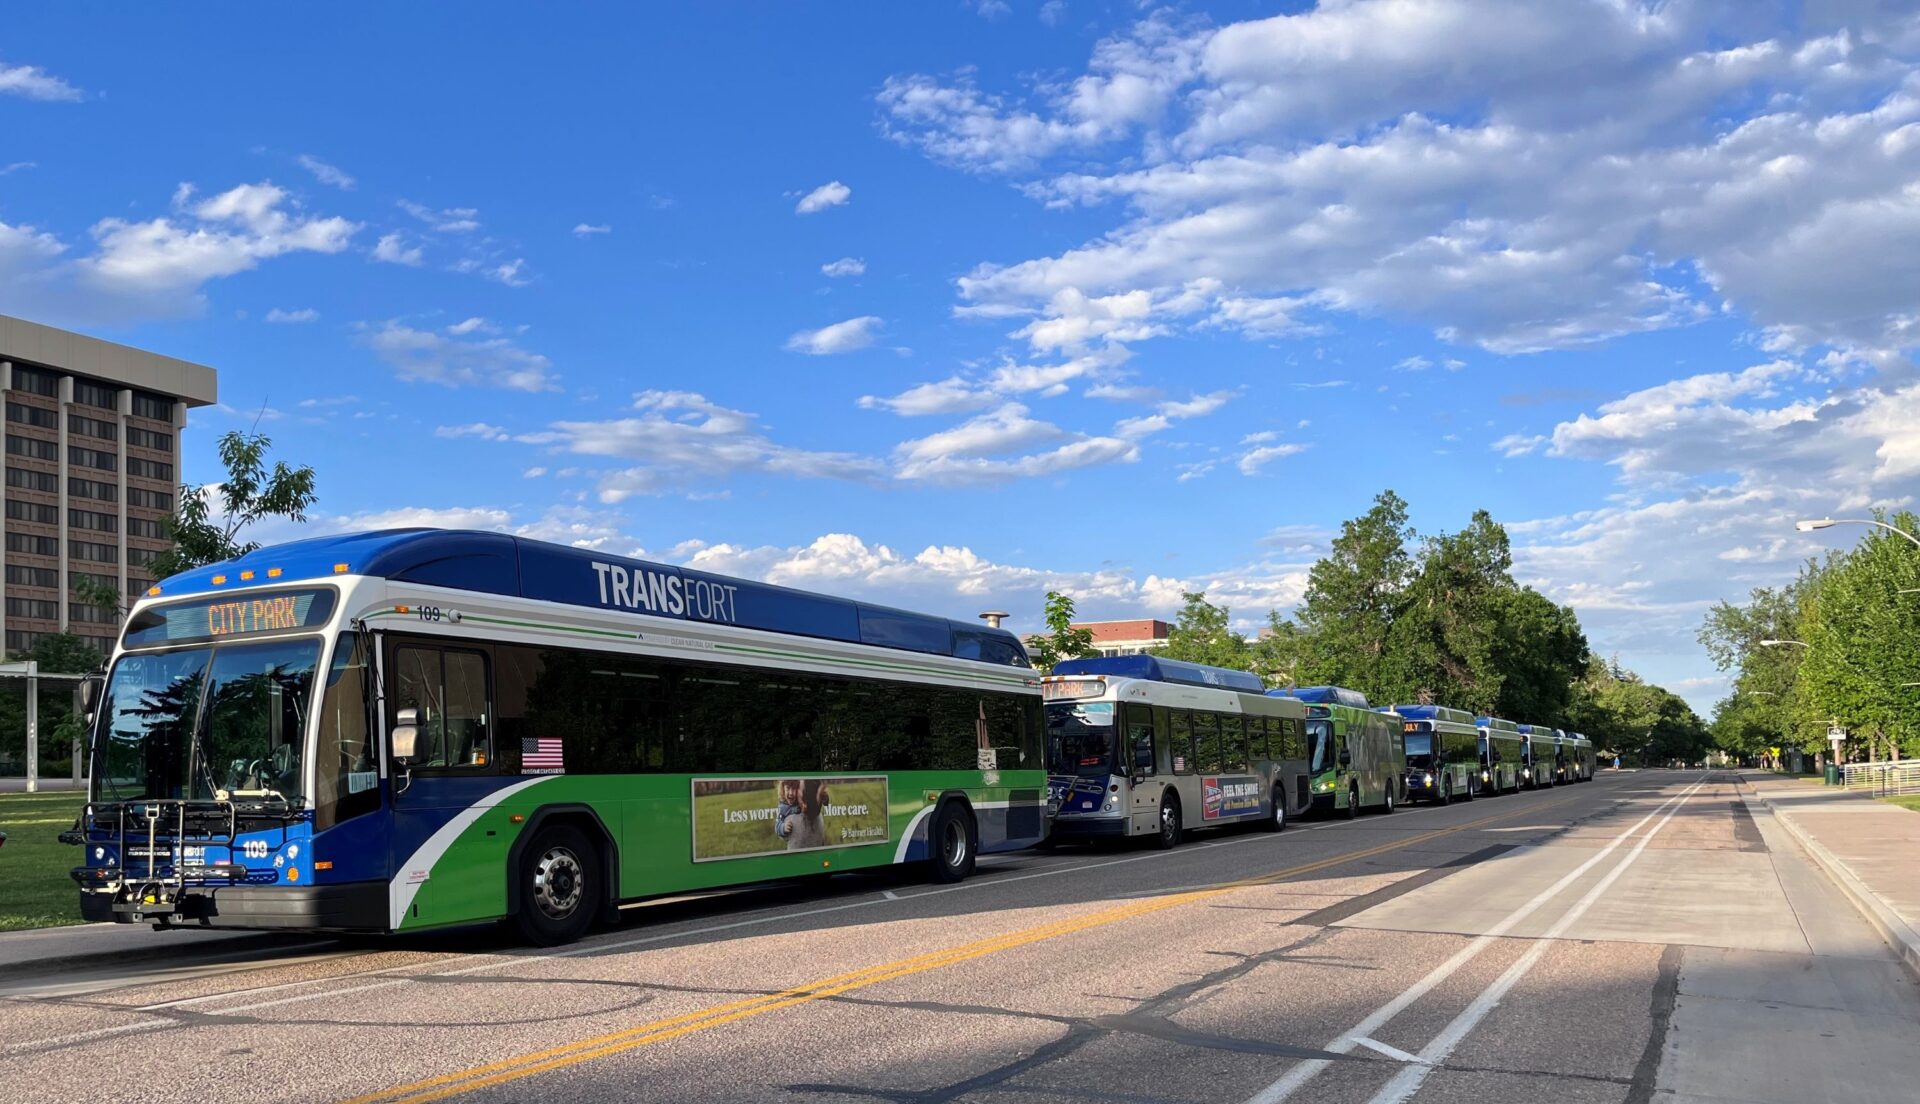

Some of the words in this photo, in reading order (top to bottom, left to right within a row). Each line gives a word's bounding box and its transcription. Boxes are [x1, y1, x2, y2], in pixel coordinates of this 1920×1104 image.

[591, 561, 737, 622] TRANSFORT
[208, 602, 247, 635] CITY
[253, 596, 297, 631] PARK
[417, 605, 440, 621] 109
[1041, 684, 1055, 699] TY
[1058, 682, 1084, 697] PARK
[1223, 784, 1235, 797] FEEL
[724, 808, 748, 823] Less
[824, 804, 847, 817] More
[848, 804, 869, 816] care.
[242, 840, 268, 858] 109
